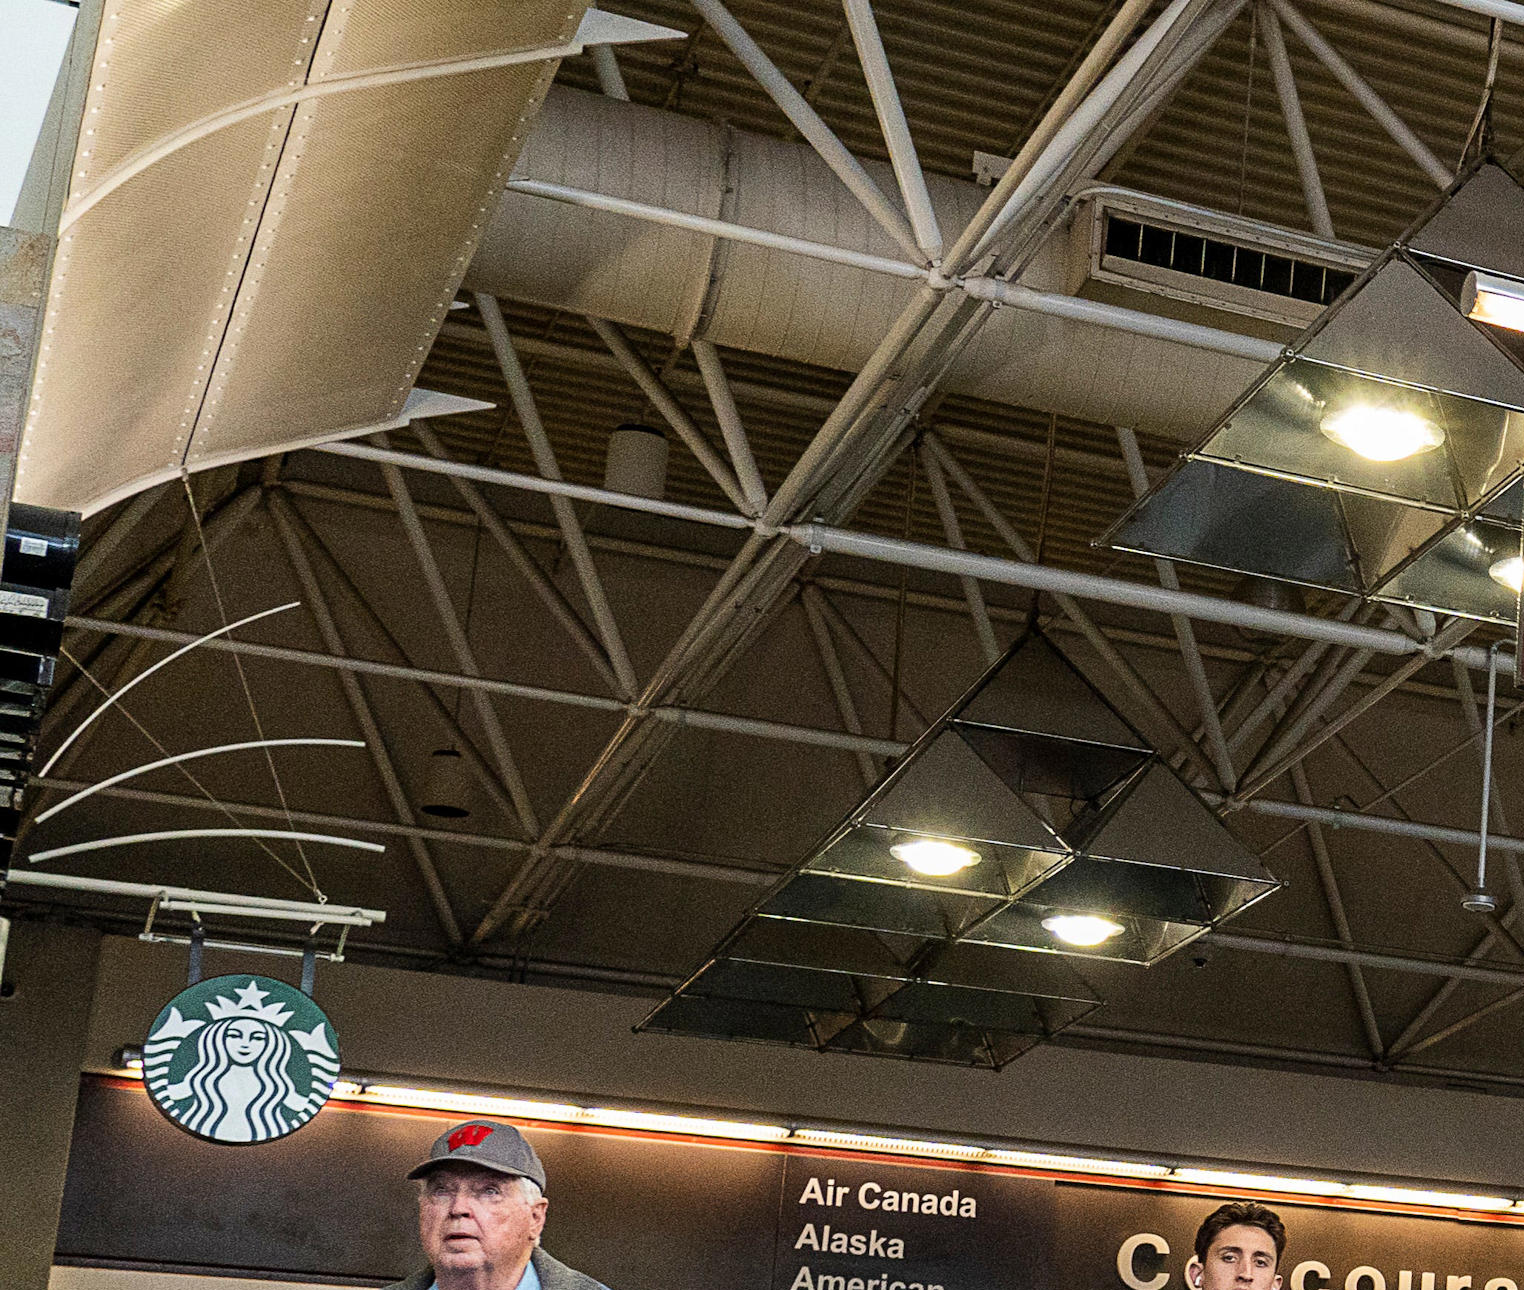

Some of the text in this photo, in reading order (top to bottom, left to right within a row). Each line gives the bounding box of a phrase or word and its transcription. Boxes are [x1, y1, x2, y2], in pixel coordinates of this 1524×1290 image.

[799, 1176, 977, 1219] Air Canada
[794, 1223, 905, 1259] Alaska
